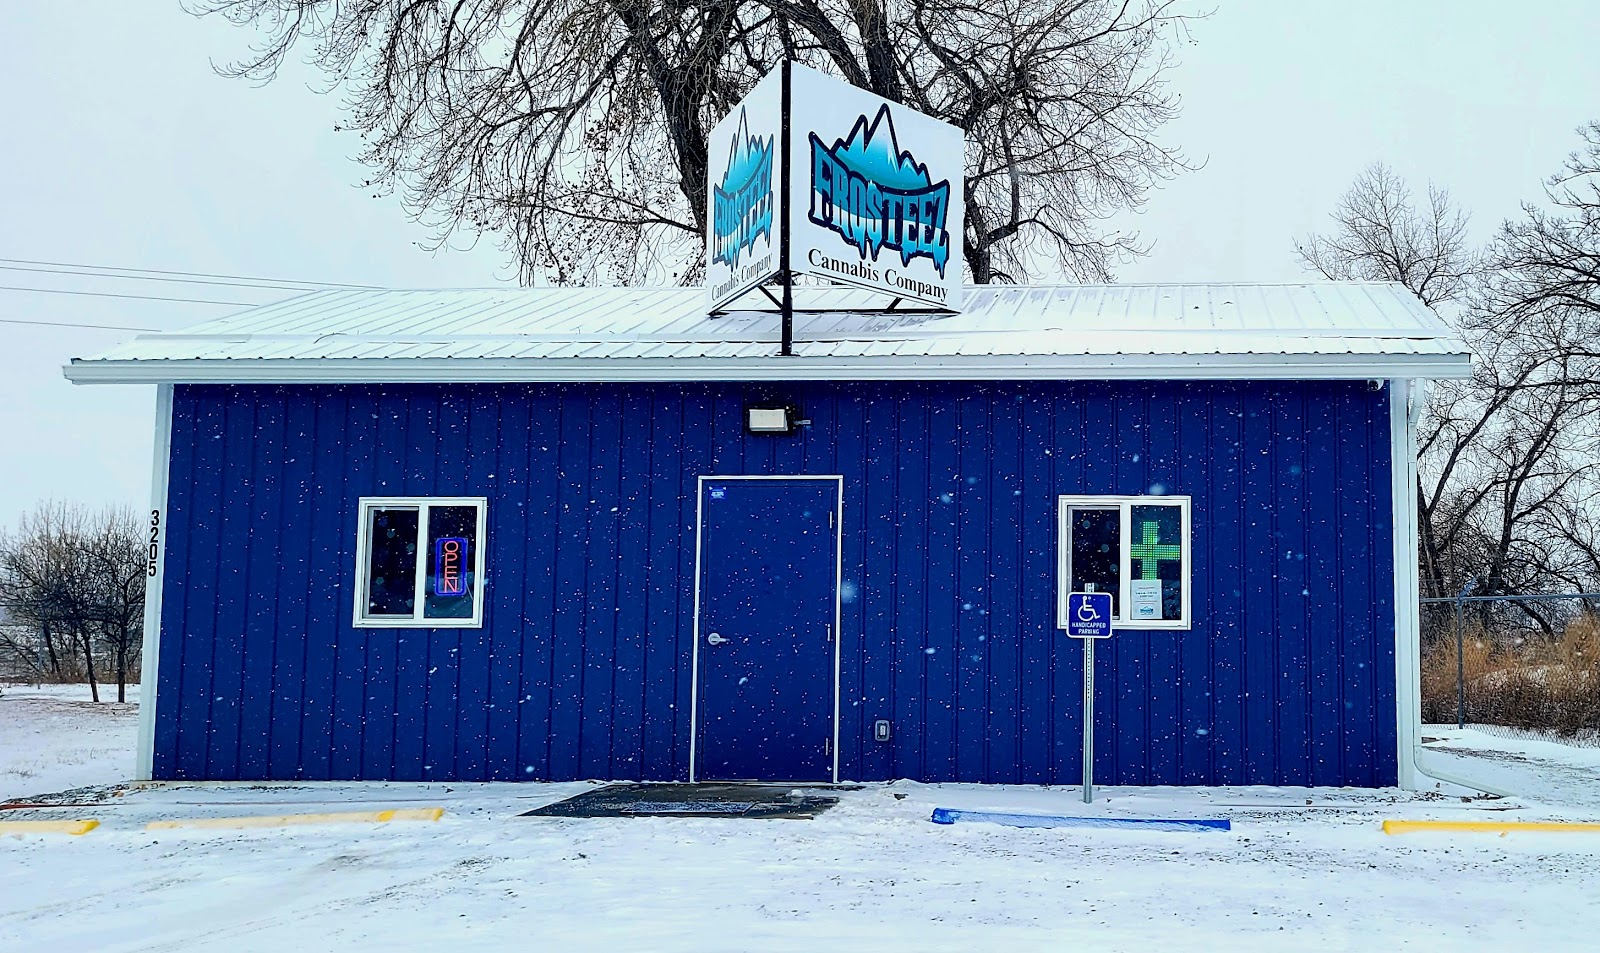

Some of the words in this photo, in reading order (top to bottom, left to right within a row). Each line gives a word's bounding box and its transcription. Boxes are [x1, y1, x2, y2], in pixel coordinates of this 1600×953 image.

[713, 134, 774, 273] FROSTEEZ
[808, 131, 951, 280] FROSTEEZ
[711, 270, 740, 301] Cannabis
[741, 253, 773, 283] Company
[808, 248, 880, 282] Cannabis
[884, 268, 949, 302] Company
[148, 509, 160, 577] 3205
[444, 540, 459, 593] OPEN
[1071, 621, 1107, 629] HANDICAPPED
